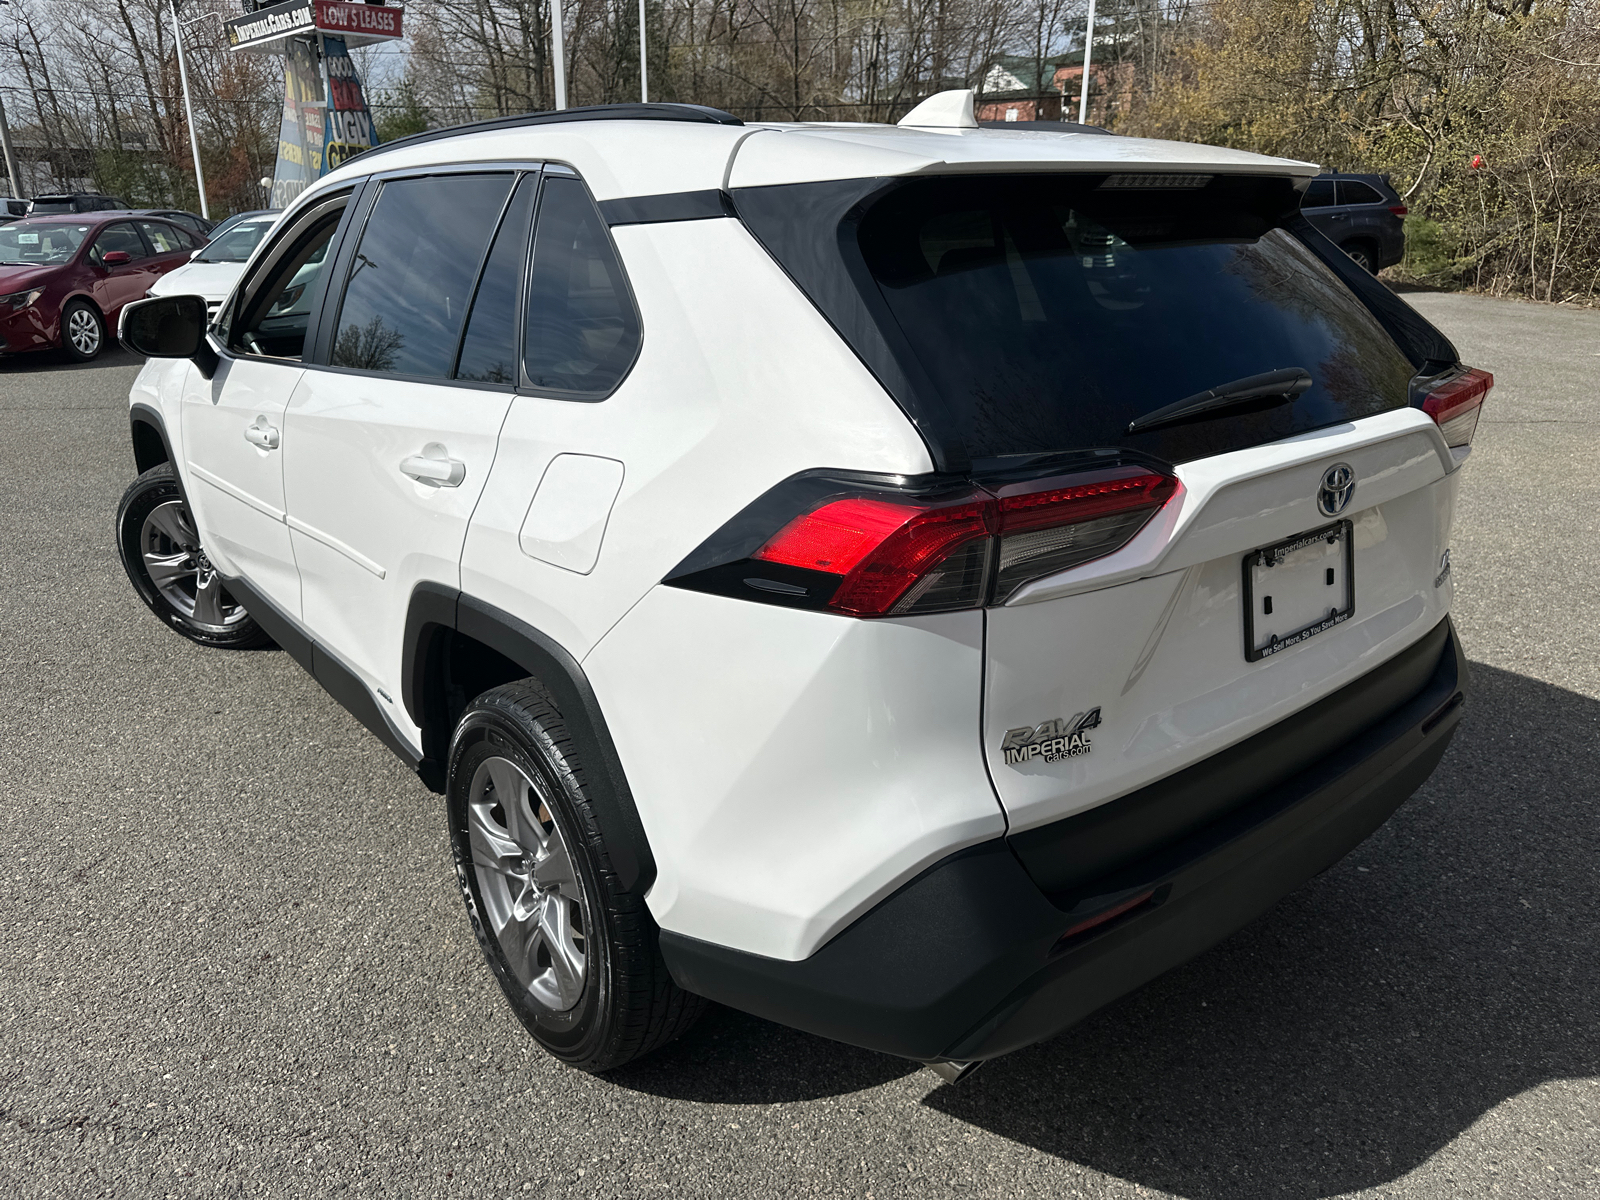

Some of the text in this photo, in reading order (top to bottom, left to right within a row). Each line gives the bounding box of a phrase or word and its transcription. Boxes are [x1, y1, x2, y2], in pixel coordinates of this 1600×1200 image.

[323, 6, 348, 26] LOW
[360, 10, 395, 31] LEASES
[328, 57, 353, 77] GOOD
[329, 111, 372, 147] UGLY
[1262, 648, 1273, 657] We
[1273, 642, 1285, 653] Sell
[1302, 630, 1310, 639] So
[1311, 626, 1321, 635] You
[1321, 620, 1334, 631] Save
[1334, 613, 1348, 624] More
[1000, 706, 1102, 750] RAV4
[1005, 732, 1092, 765] IMPERIAL
[1046, 744, 1092, 763] cars.com
